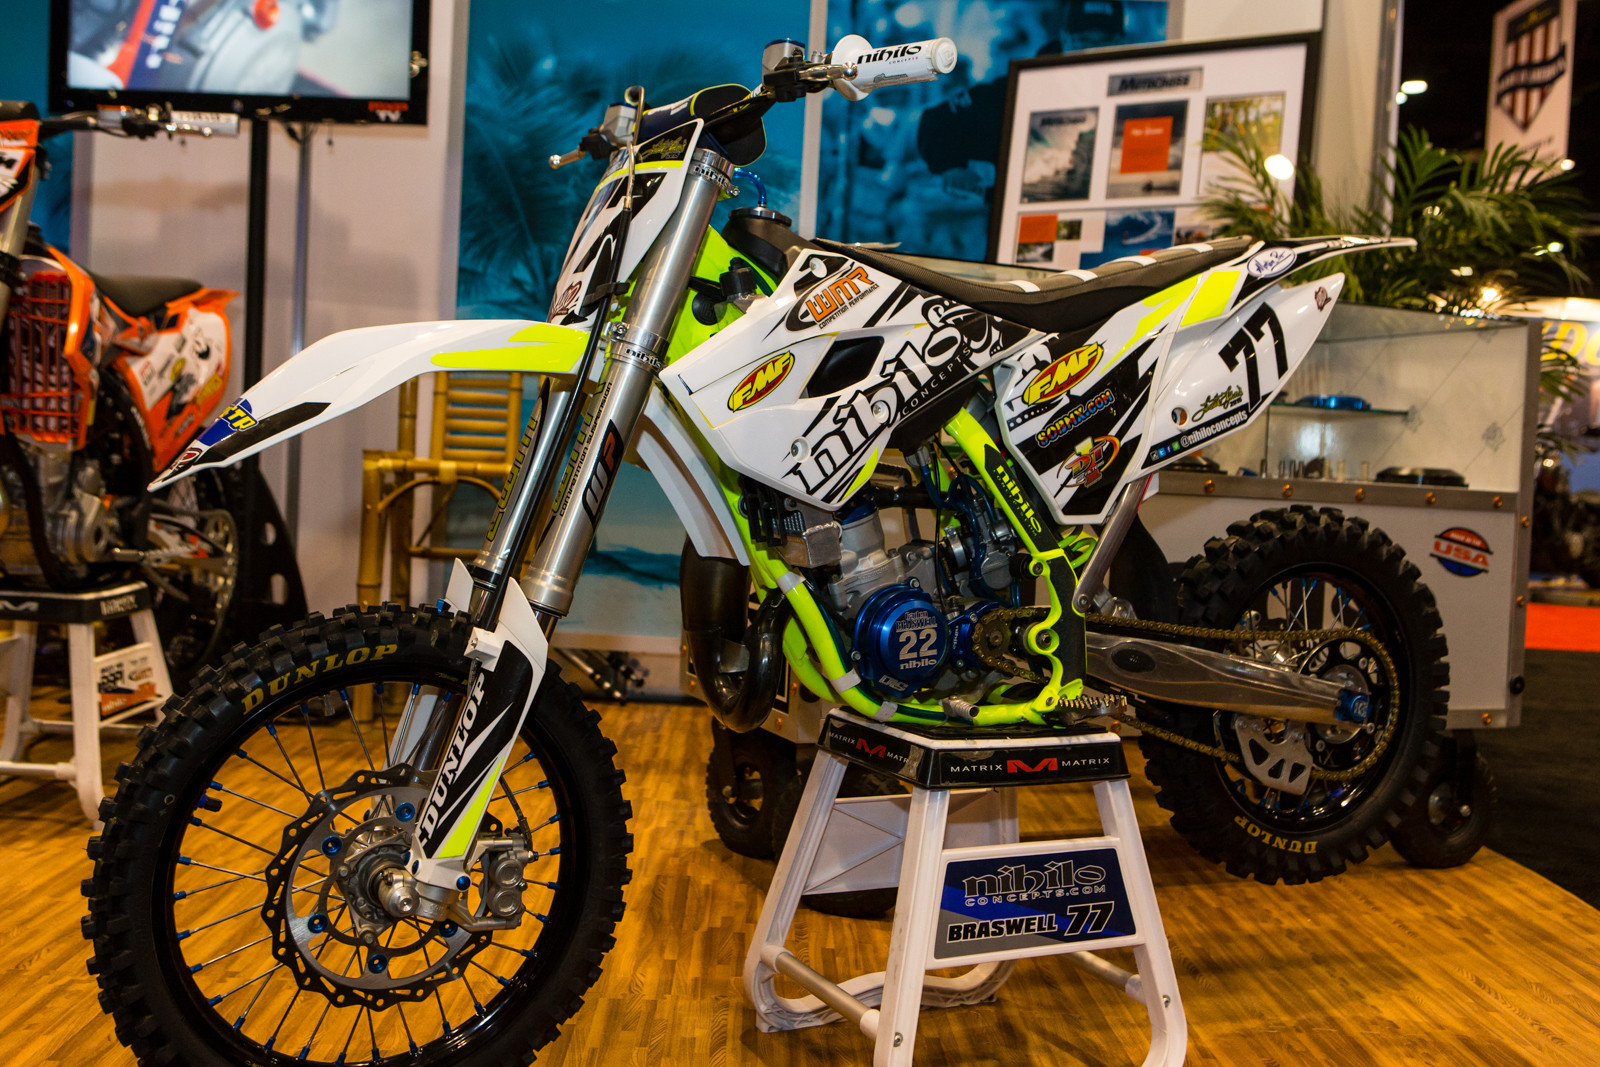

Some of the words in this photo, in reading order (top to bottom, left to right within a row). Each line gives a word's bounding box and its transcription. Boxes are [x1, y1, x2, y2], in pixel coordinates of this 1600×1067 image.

[857, 45, 922, 64] nihilo
[806, 266, 875, 323] WMR
[819, 304, 849, 329] COMPETITION
[848, 283, 880, 307] PERFORMANCE
[1028, 342, 1099, 406] FMF
[1218, 302, 1289, 411] 77
[732, 350, 791, 413] FMF
[902, 347, 973, 415] CONCEPTS
[792, 325, 963, 495] nihilo
[1036, 389, 1114, 446] SOBMX.COM
[1180, 410, 1248, 448] @nihiloconcepts
[559, 447, 588, 517] COMPETITION
[586, 382, 613, 446] SUSPENSION
[996, 465, 1042, 533] nihilo
[1434, 541, 1489, 567] USA
[899, 628, 938, 660] 22
[900, 659, 937, 669] nihilo
[241, 643, 398, 715] DUNLOP
[421, 673, 486, 842] DUNLOP
[829, 731, 856, 745] MATRIX
[887, 751, 910, 766] MATR
[950, 763, 1003, 773] MATRIX
[1061, 757, 1111, 767] MATRIX
[1234, 815, 1318, 854] DUNLOP
[962, 859, 1107, 898] nihilo
[964, 884, 1107, 907] CONCEPTS.COM
[947, 913, 1058, 943] BRASWELL
[1063, 900, 1115, 937] 77
